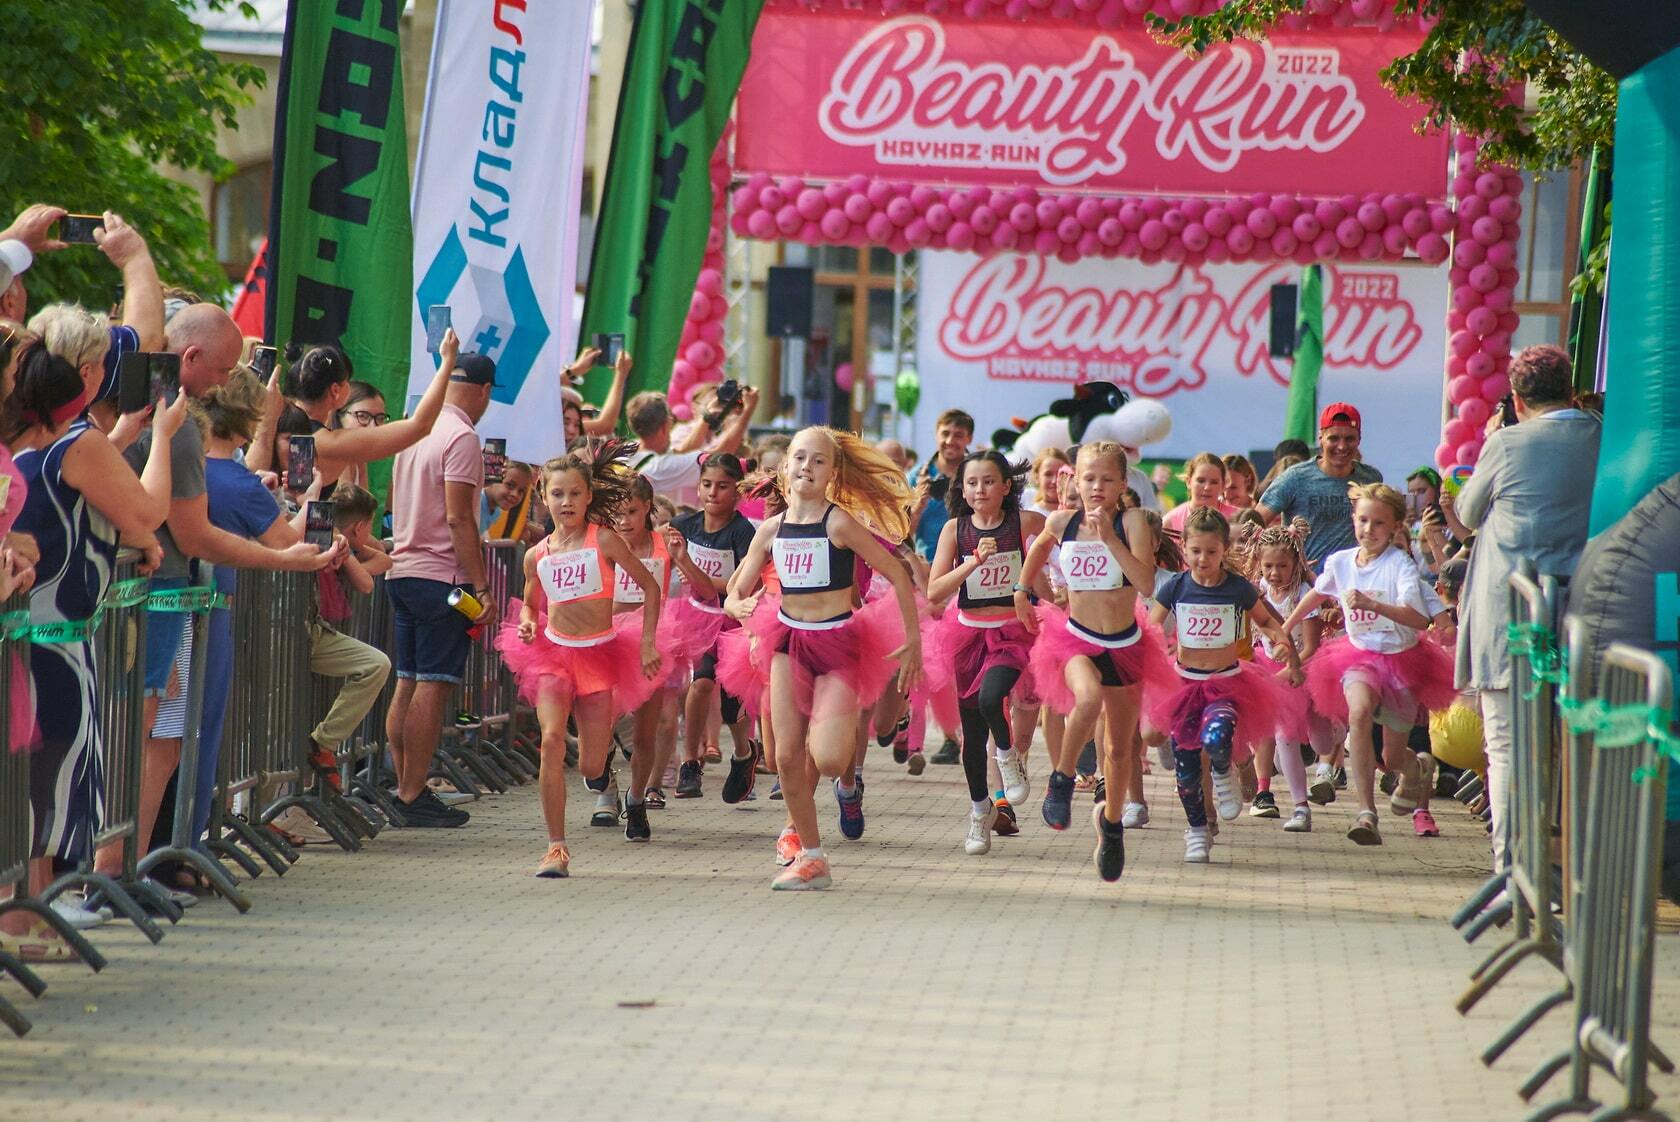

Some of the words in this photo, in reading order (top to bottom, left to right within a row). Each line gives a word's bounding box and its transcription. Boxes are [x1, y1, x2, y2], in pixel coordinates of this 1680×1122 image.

[1277, 55, 1333, 75] 2022
[827, 22, 1143, 177] Beauty
[1152, 40, 1358, 166] Run
[1342, 277, 1394, 298] 2022
[942, 250, 1223, 394] Beauty
[784, 553, 814, 574] 414
[1070, 556, 1108, 577] 262
[552, 563, 587, 589] 424
[980, 565, 1011, 587] 212
[1187, 616, 1223, 637] 222
